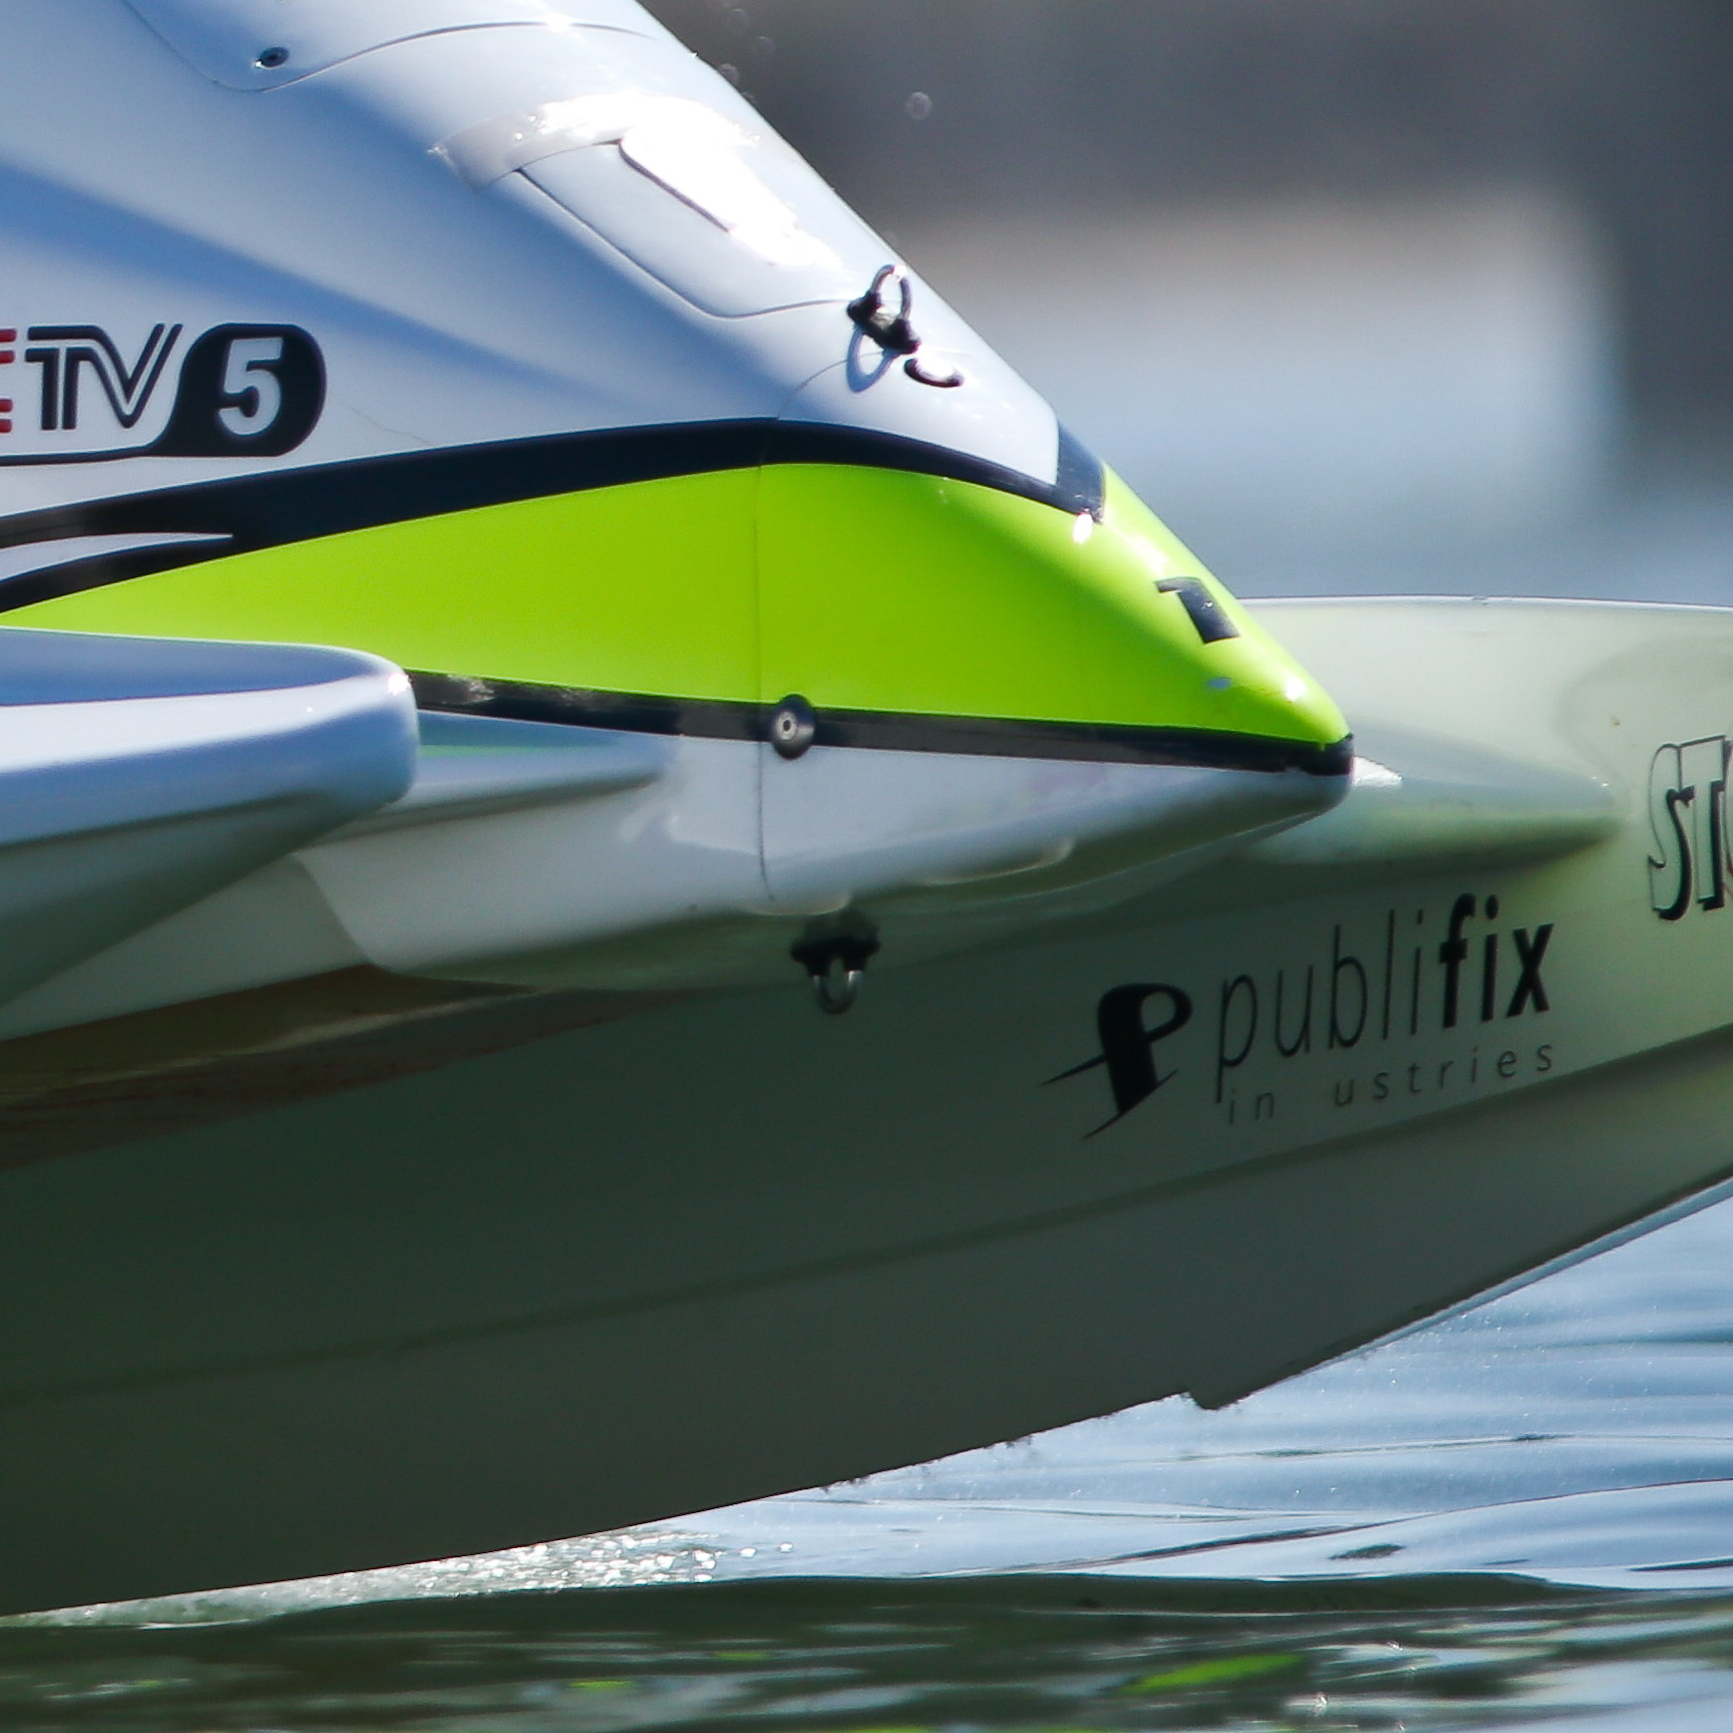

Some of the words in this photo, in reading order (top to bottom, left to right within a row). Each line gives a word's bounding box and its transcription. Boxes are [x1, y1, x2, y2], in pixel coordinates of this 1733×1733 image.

[215, 337, 285, 437] 5
[1648, 735, 1733, 920] ST
[1215, 893, 1555, 1104] publifix
